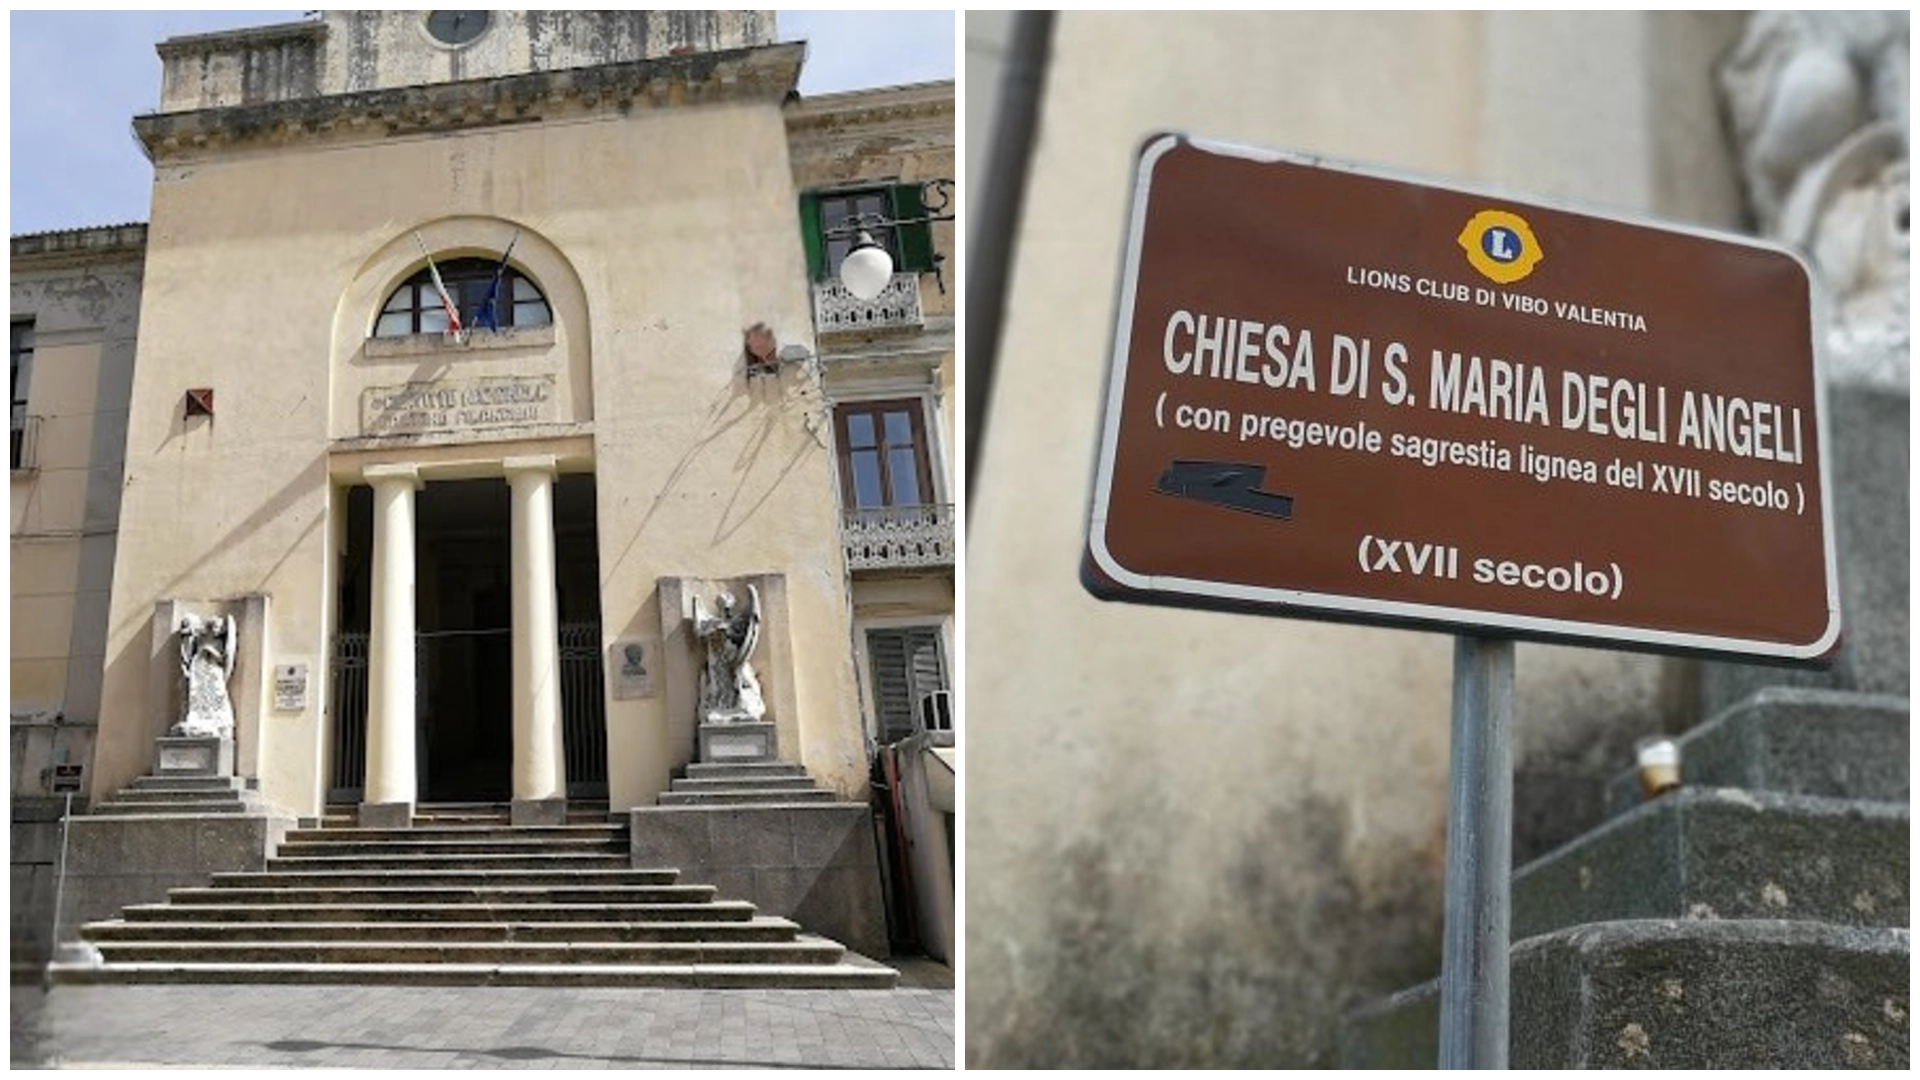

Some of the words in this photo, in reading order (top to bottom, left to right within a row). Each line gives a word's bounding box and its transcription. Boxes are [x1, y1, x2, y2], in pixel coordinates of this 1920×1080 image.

[1347, 266, 1411, 293] LIONS
[1416, 278, 1470, 302] CLUB
[1475, 288, 1496, 307] DI
[1501, 292, 1549, 316] VIBO
[1554, 301, 1647, 332] VALENTIA
[1163, 310, 1316, 392] CHIESA
[1329, 334, 1371, 399] DI
[1381, 342, 1416, 407] S.
[1429, 349, 1550, 427] MARIA
[1562, 370, 1667, 444] DEGLI
[1678, 390, 1803, 465] ANGELI
[1239, 413, 1382, 453] pregevole
[1390, 433, 1512, 471] sagrestia
[1519, 444, 1597, 484] lignea
[1605, 458, 1644, 490] del
[1652, 463, 1701, 498] XVII
[1358, 534, 1458, 580] (XVII
[1472, 558, 1623, 600] secolo)
